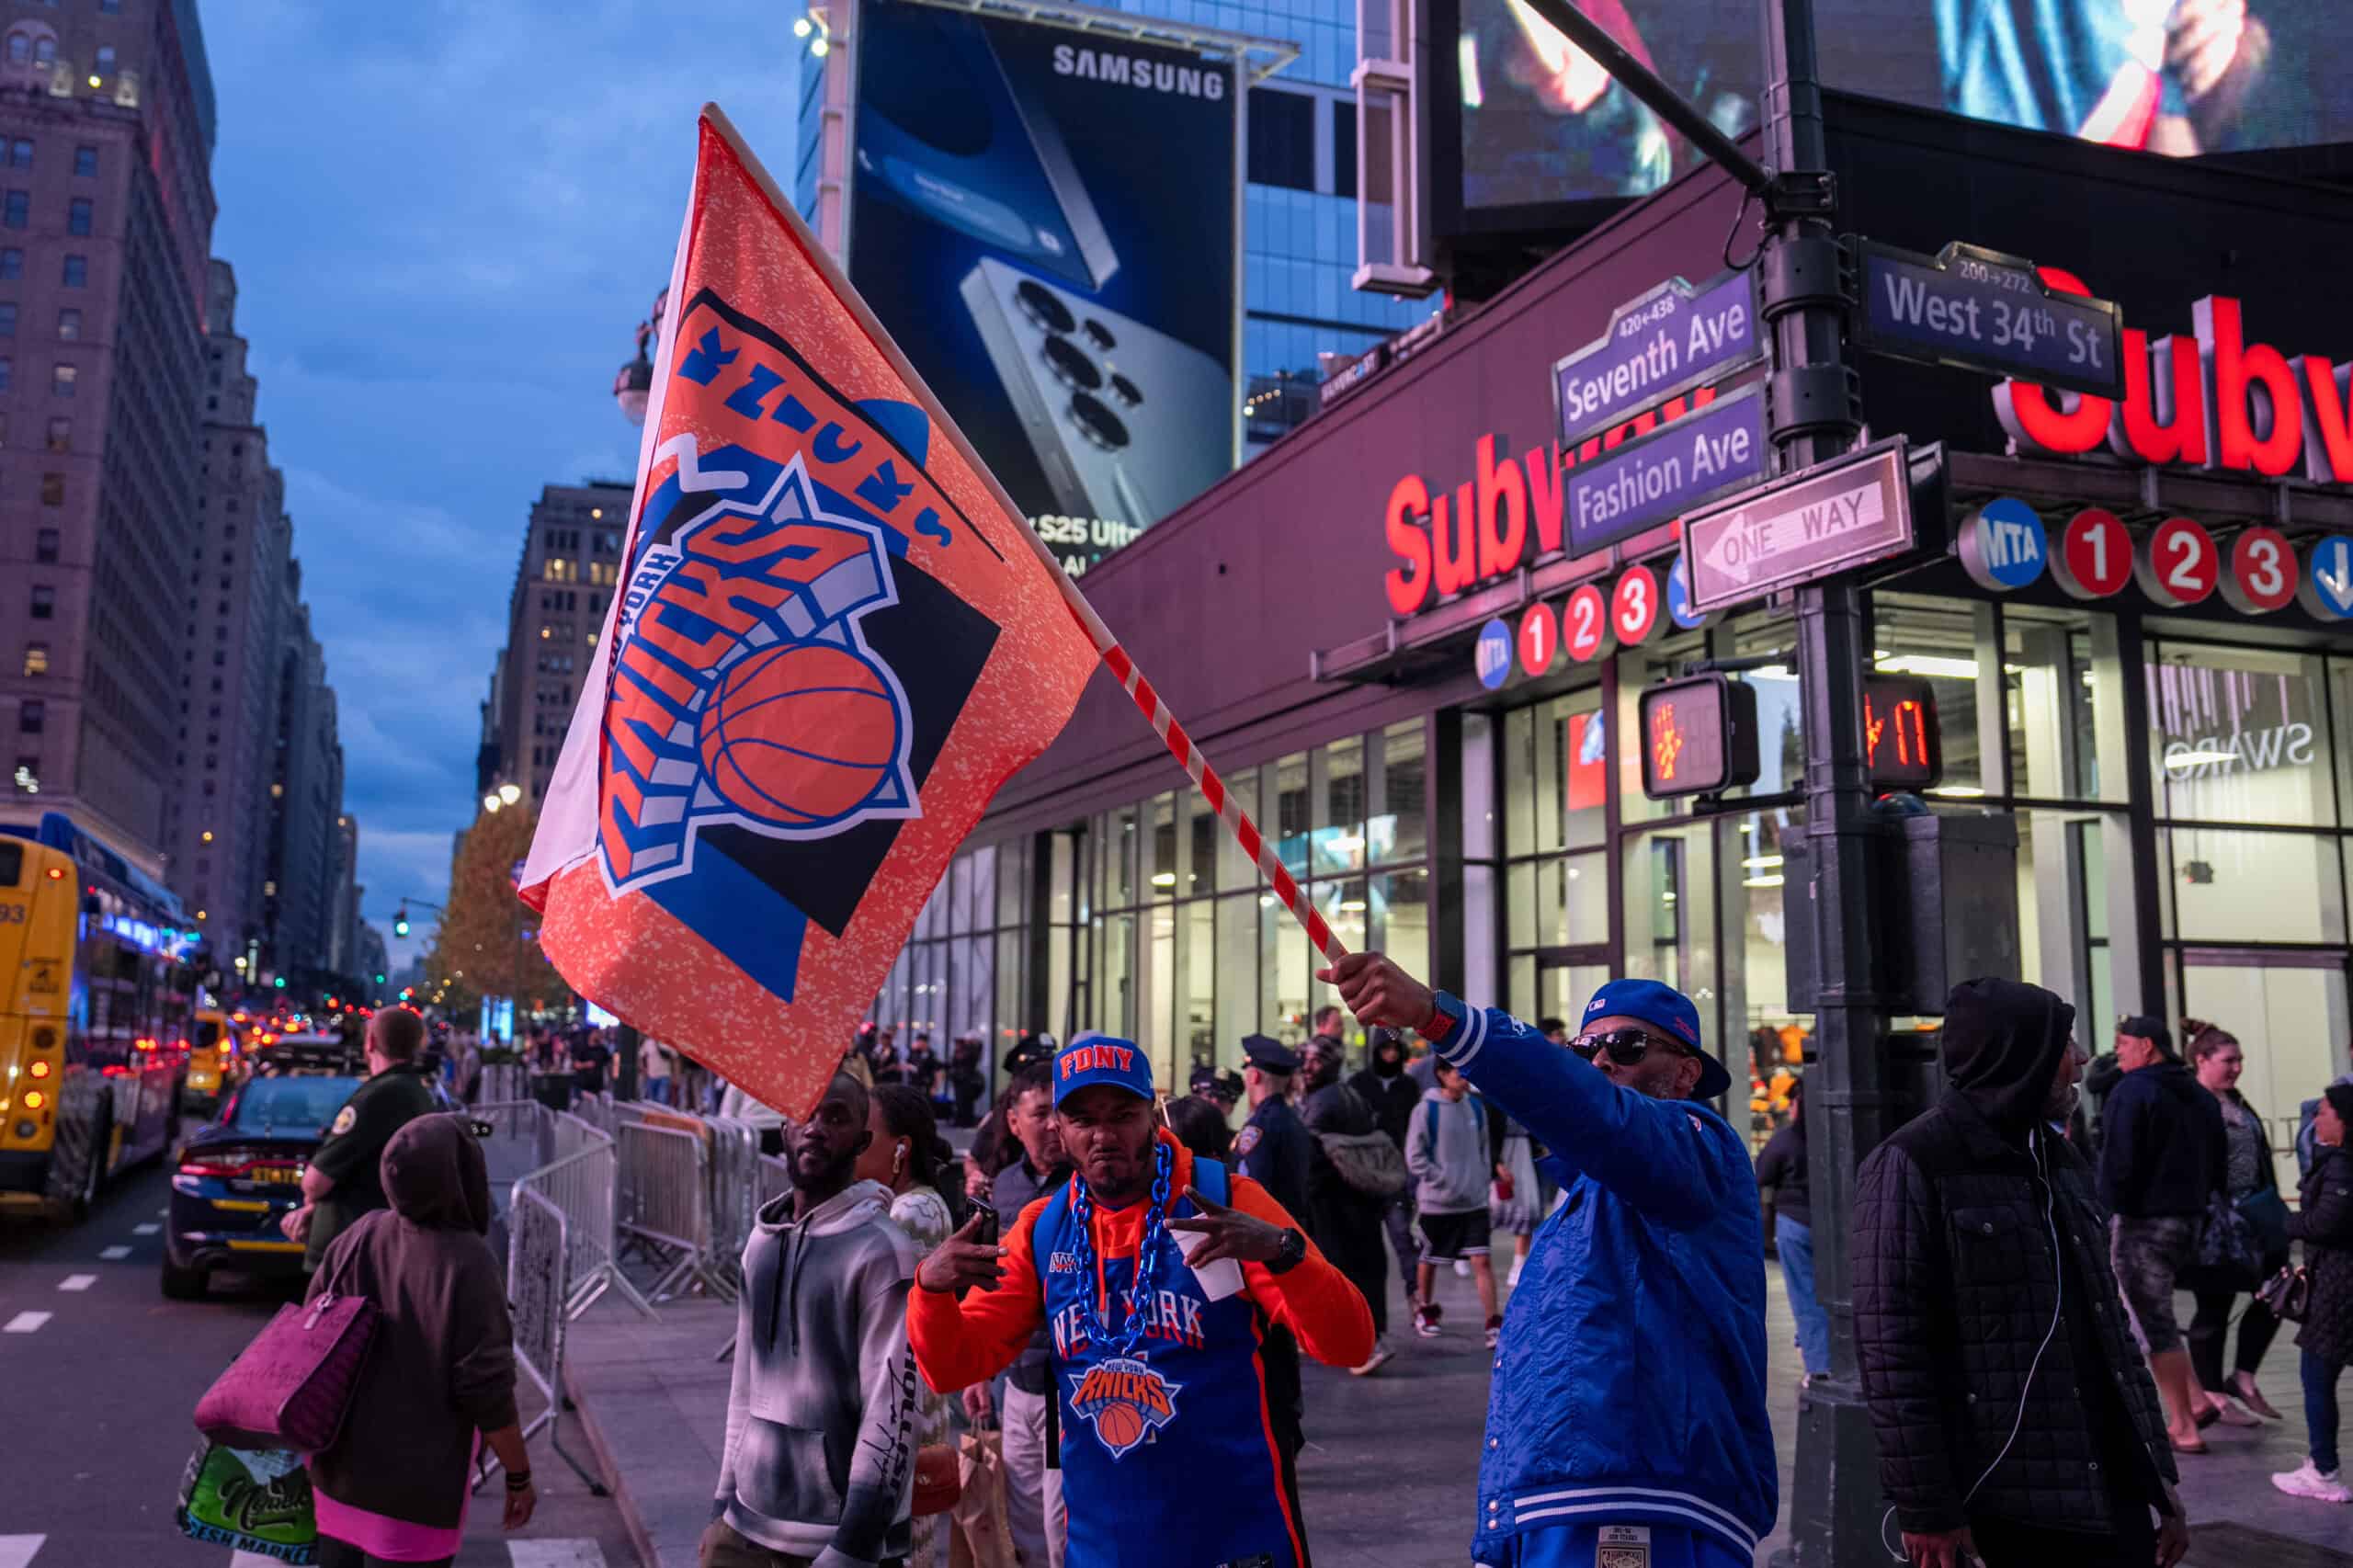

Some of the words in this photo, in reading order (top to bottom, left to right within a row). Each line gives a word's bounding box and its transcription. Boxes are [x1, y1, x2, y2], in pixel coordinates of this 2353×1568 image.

[1053, 44, 1223, 100] SAMSUNG
[1885, 273, 1981, 340] West
[1992, 301, 2055, 351] 34th
[2067, 319, 2102, 368] St
[1567, 329, 1677, 422] Seventh
[1688, 304, 1745, 362] Ave
[677, 325, 952, 548] KNICKS
[1578, 457, 1682, 529] Fashion
[1692, 427, 1750, 483] Ave
[1039, 514, 1088, 544] S25
[1723, 524, 1778, 566] ONE
[1802, 492, 1863, 540] WAY
[1978, 517, 2040, 570] MTA
[2082, 523, 2108, 581] 1
[2167, 530, 2203, 590] 2
[2247, 539, 2284, 597] 3
[619, 551, 678, 629] YORK
[1529, 615, 1543, 662] 1
[1574, 597, 1596, 649] 2
[1621, 577, 1646, 632] 3
[600, 513, 870, 881] KNICKS
[1059, 1044, 1134, 1082] FDNY
[1073, 1369, 1171, 1416] KNICKS
